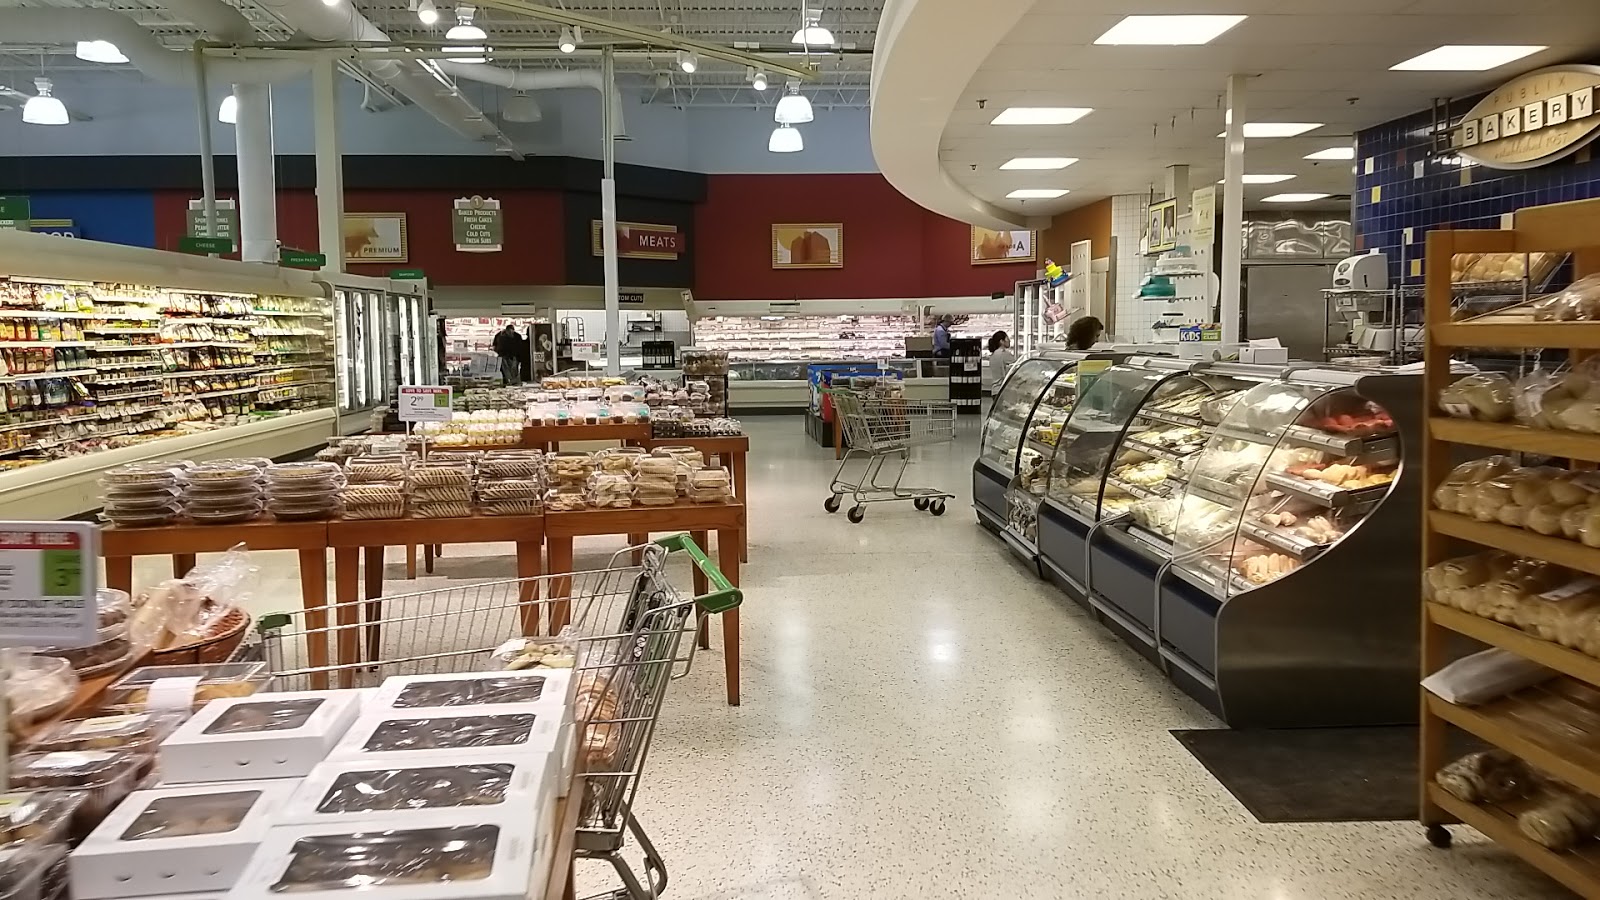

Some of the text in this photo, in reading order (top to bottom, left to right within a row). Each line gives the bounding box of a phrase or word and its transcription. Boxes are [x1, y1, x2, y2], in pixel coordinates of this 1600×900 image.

[1494, 76, 1565, 105] PUBLIX
[1465, 94, 1588, 141] BAKERY
[474, 197, 479, 206] 1
[639, 234, 676, 248] MEATS
[1015, 240, 1025, 251] A
